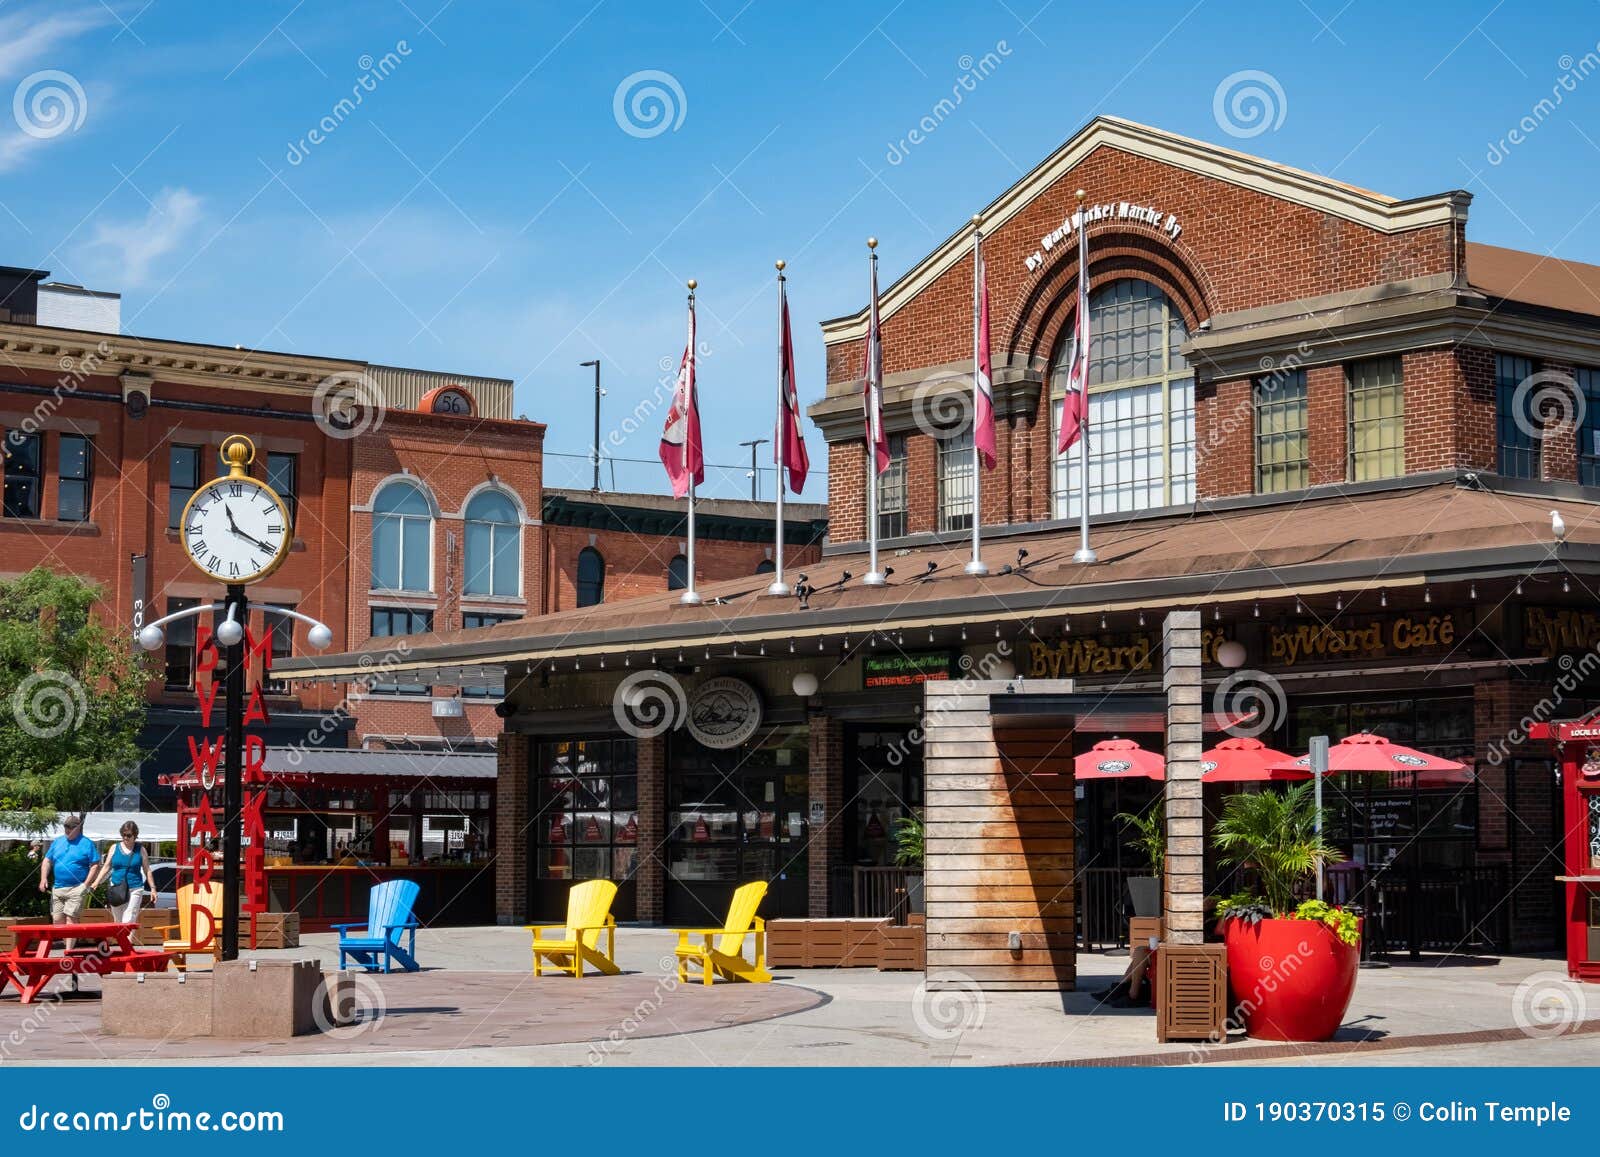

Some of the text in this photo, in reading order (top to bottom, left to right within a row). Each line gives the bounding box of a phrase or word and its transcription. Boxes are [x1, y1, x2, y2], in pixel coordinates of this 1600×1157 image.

[1025, 250, 1043, 272] By
[1041, 217, 1072, 251] Ward
[1071, 202, 1116, 230] Market
[1165, 214, 1183, 239] By
[444, 395, 460, 413] 56
[1392, 614, 1454, 649] Café
[1029, 638, 1152, 680] ByWard
[1570, 728, 1592, 737] LOCAL
